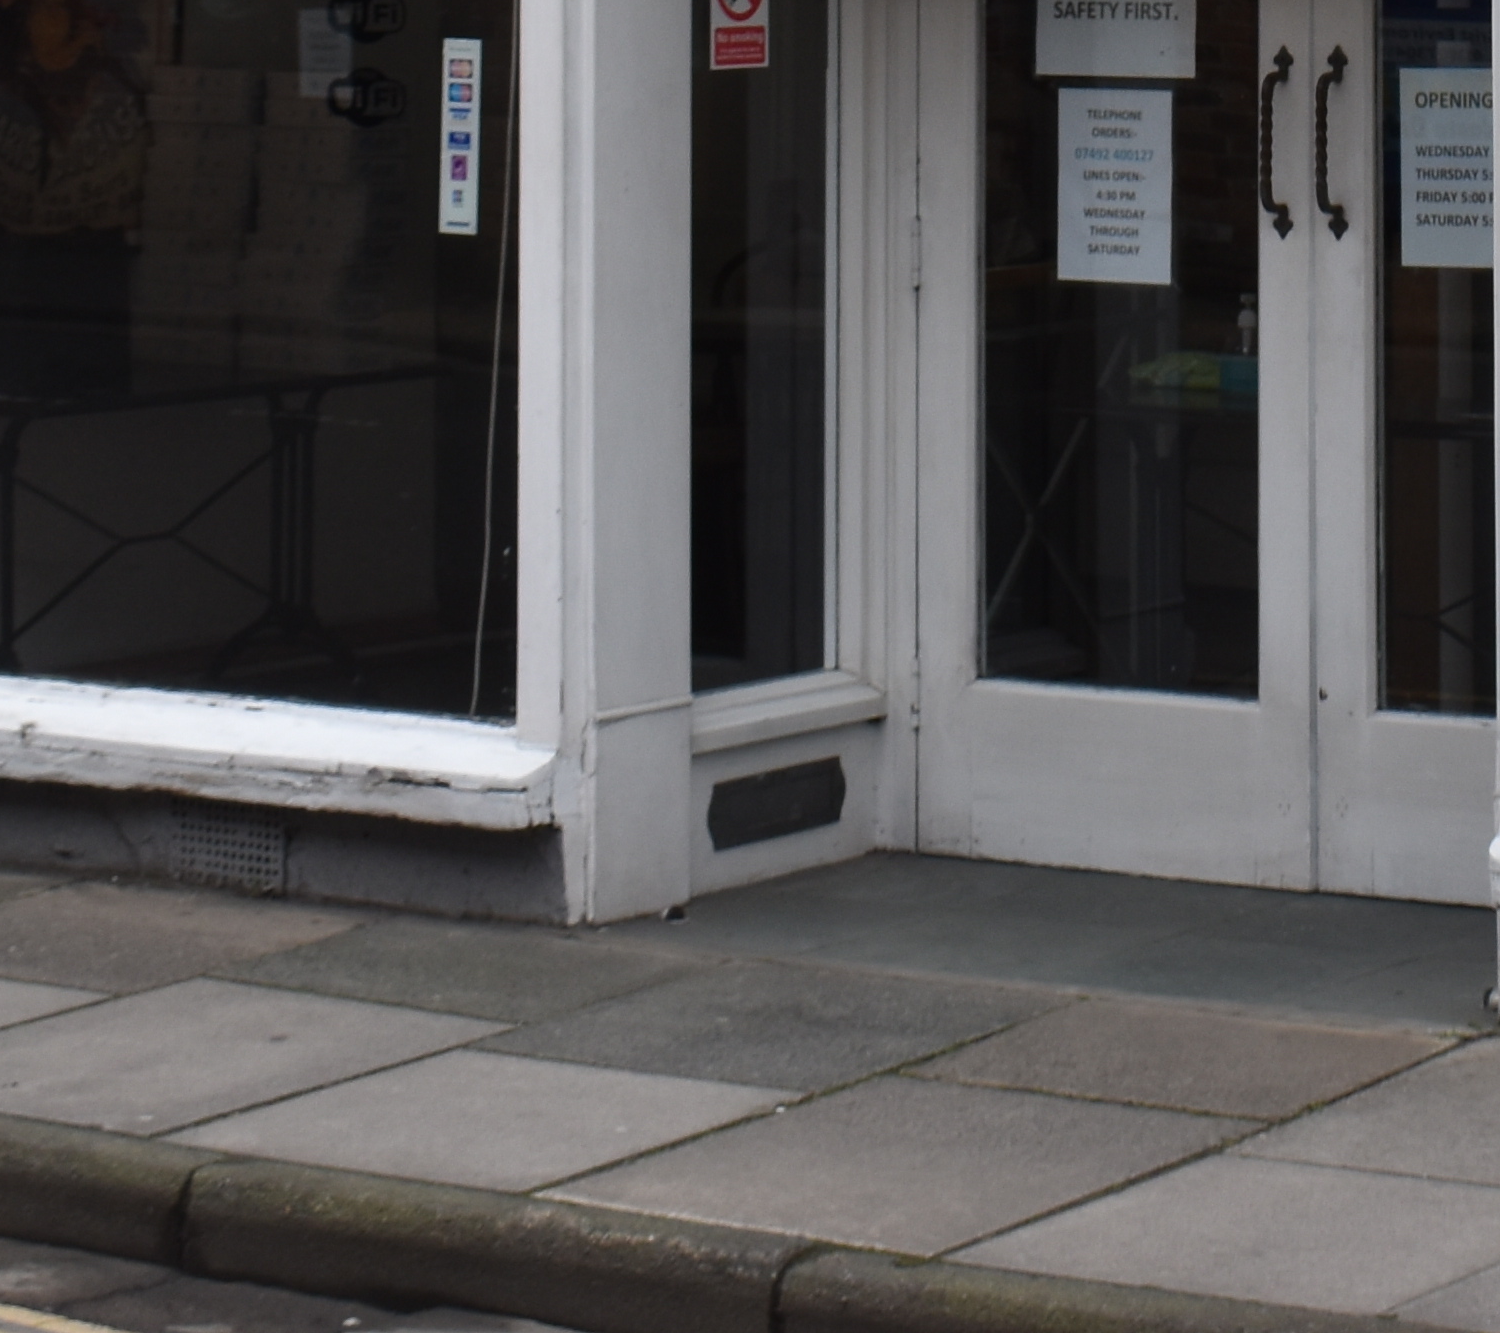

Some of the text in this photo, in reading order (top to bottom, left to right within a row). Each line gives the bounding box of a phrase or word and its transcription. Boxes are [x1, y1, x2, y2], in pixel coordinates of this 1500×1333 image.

[1053, 1, 1179, 21] SAFETY FIRST.
[1415, 92, 1493, 109] OPENING
[1087, 109, 1143, 121] TELEPHONE
[1416, 145, 1489, 158] WEDNESDAY
[1084, 170, 1112, 181] LINES
[1416, 168, 1478, 181] THURSDAY
[1119, 191, 1136, 201] PM
[1416, 191, 1457, 204] FRIDAY
[1461, 192, 1486, 204] 5:00
[1084, 208, 1145, 220] WEDNESDAY
[1416, 214, 1478, 227] SATURDAY
[1090, 225, 1139, 237] THROUGH
[1087, 244, 1140, 256] SATURDAY
